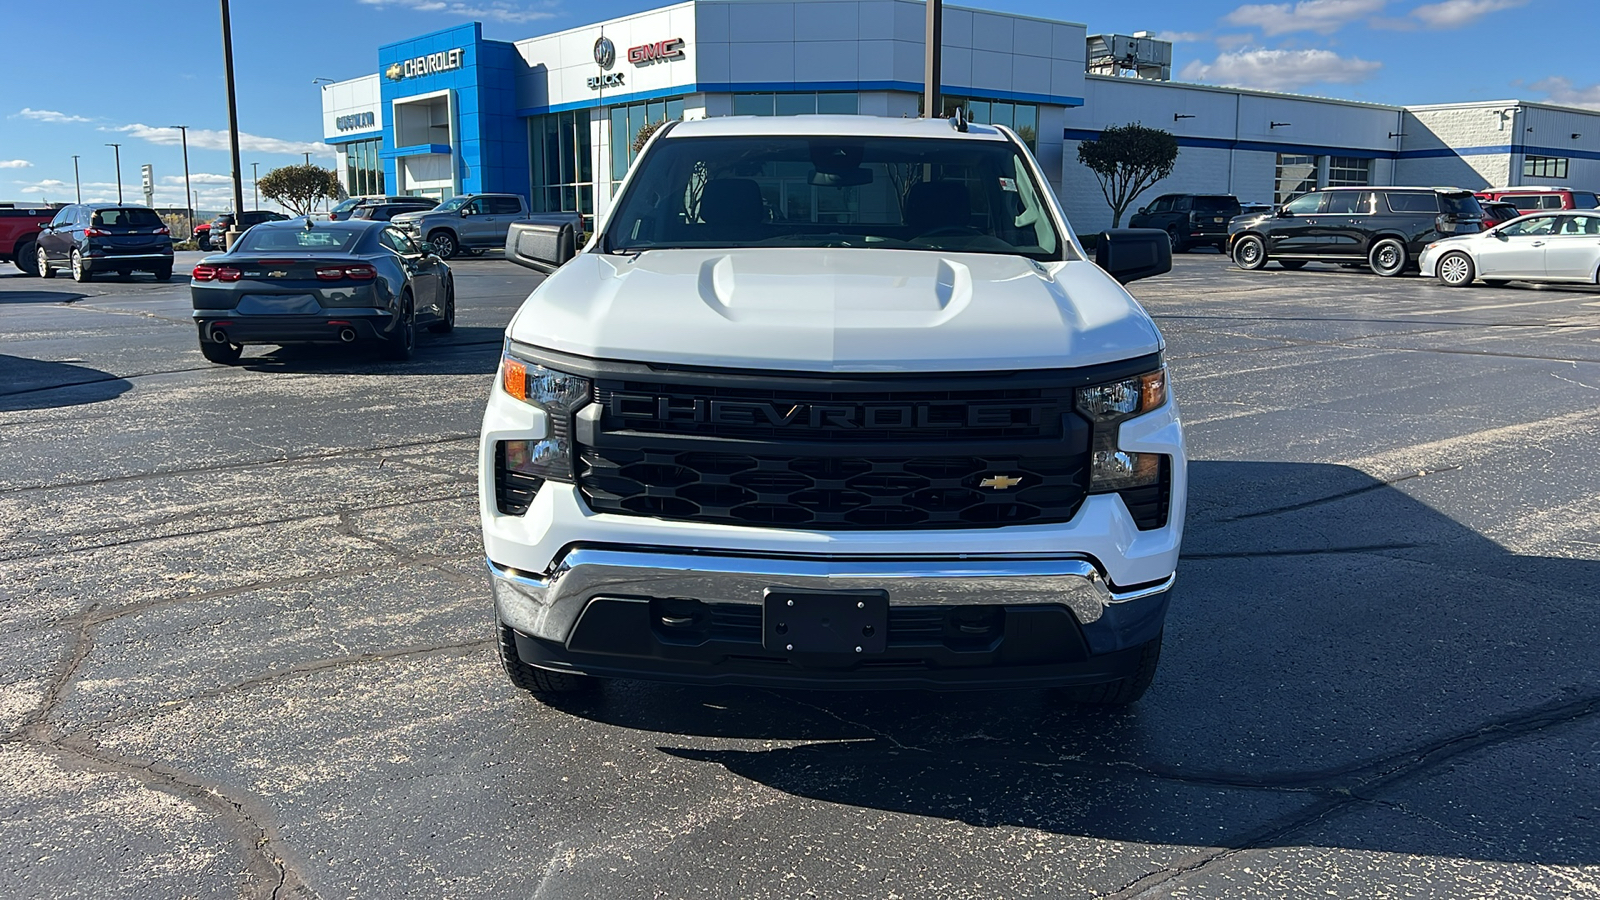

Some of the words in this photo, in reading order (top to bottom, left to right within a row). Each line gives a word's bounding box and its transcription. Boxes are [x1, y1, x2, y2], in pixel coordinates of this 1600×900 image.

[404, 48, 465, 78] CHEVROLET
[627, 38, 684, 66] GMC
[587, 73, 625, 90] BUICK
[610, 392, 1057, 429] CHEVROLET
